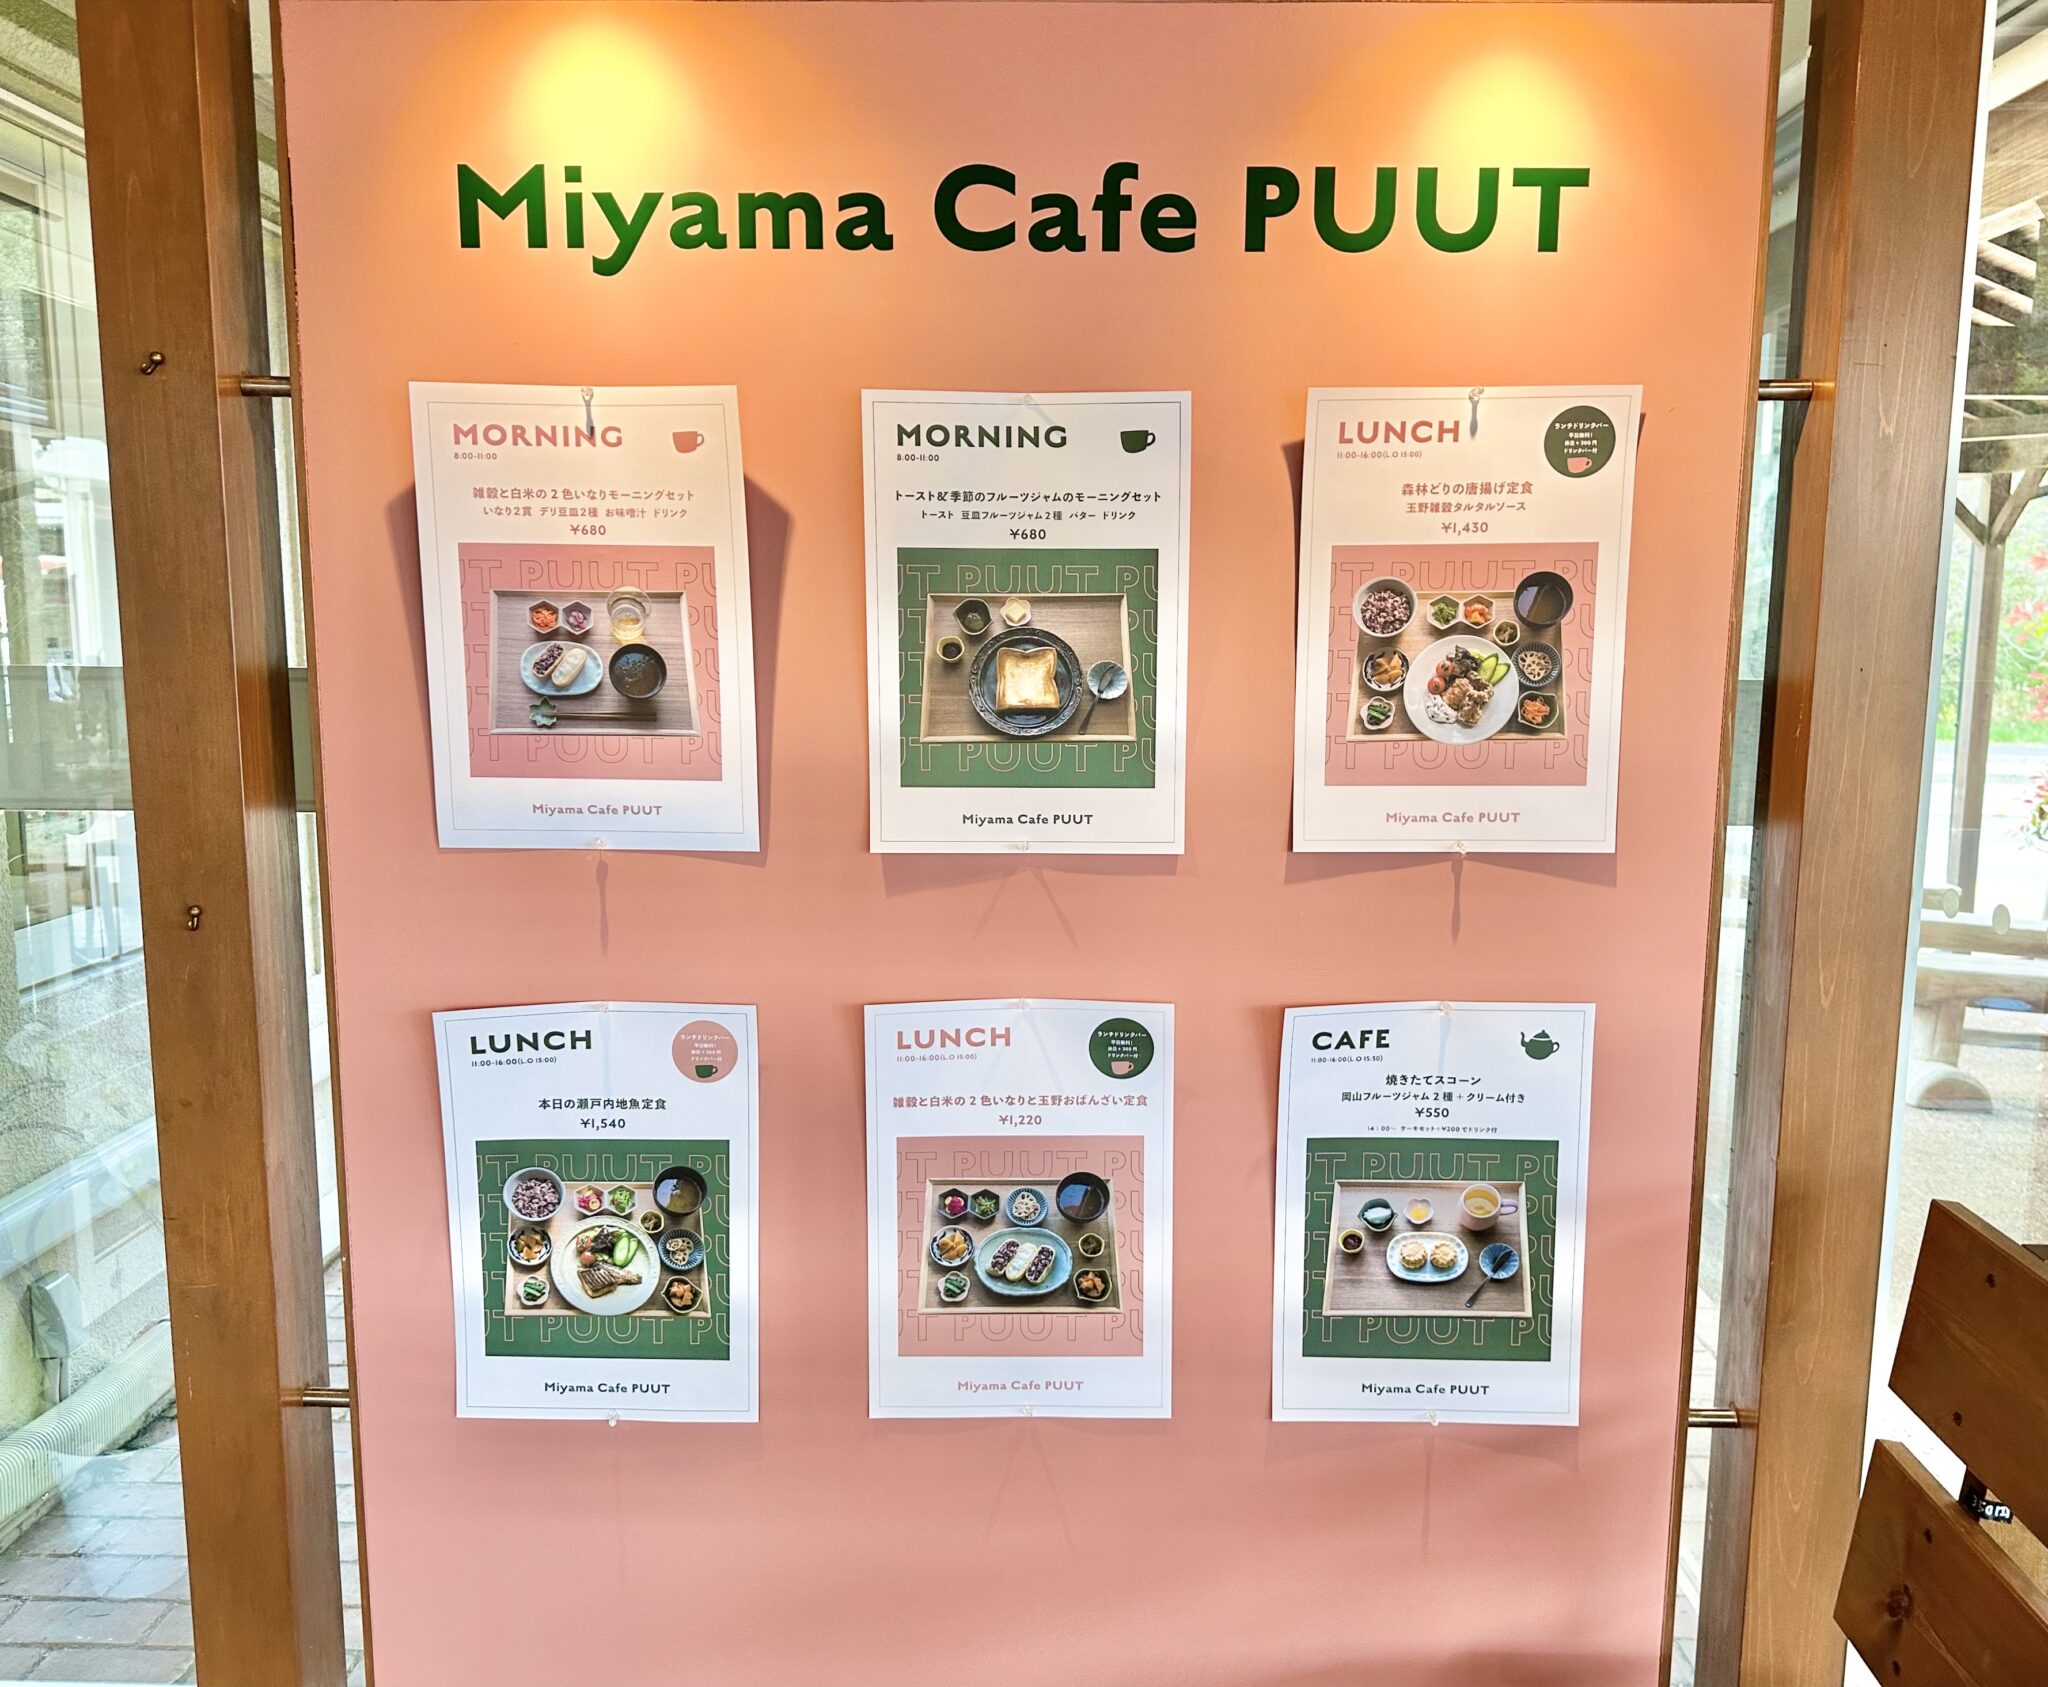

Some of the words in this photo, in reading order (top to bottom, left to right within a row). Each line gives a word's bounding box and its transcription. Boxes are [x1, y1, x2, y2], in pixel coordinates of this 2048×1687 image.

[456, 163, 894, 277] Miyama
[933, 161, 1197, 254] Cafe
[1244, 166, 1591, 254] PUUT
[453, 423, 623, 448] MORNING
[896, 423, 1067, 449] MORNING
[1338, 420, 1460, 445] LUNCH
[453, 451, 498, 461] 8:00-11:00
[896, 453, 940, 462] 8:00-11:00
[1401, 480, 1534, 497] 森林どりの唐揚げ定食
[653, 508, 688, 519] ドリンク
[921, 509, 954, 520] トースト
[1068, 511, 1096, 521] バター
[1103, 510, 1136, 521] ドリンク
[570, 524, 607, 536] ¥680
[1009, 528, 1047, 540] ¥680
[1441, 521, 1489, 537] ¥1,430
[957, 565, 1099, 593] PUUT
[958, 742, 1098, 772] PUUT
[532, 803, 584, 817] Miyama
[587, 804, 619, 815] Cafe
[622, 805, 663, 816] PUUT
[962, 814, 1014, 828] Miyama
[1017, 813, 1049, 825] Cafe
[1053, 814, 1094, 825] PUUT
[1385, 812, 1438, 826] Miyama
[1441, 811, 1474, 823] Cafe
[1478, 812, 1521, 823] PUUT
[470, 1029, 592, 1055] LUNCH
[897, 1026, 1011, 1050] LUNCH
[1311, 1028, 1390, 1051] CAFE
[1385, 1073, 1482, 1086] 焼きたてスコーン
[538, 1097, 667, 1110] 本日の瀬戸内地魚定食
[1415, 1107, 1450, 1118] ¥550
[580, 1118, 626, 1131] ¥1,540
[998, 1114, 1042, 1128] ¥1,220
[953, 1151, 1087, 1178] PUUT
[1362, 1152, 1500, 1180] PUUT
[544, 1382, 594, 1395] Miyama
[597, 1382, 628, 1393] Cafe
[632, 1383, 671, 1394] PUUT
[957, 1380, 1007, 1394] Miyama
[1010, 1379, 1041, 1391] Cafe
[1044, 1380, 1084, 1391] PUUT
[1361, 1383, 1412, 1396] Miyama
[1415, 1383, 1446, 1394] Cafe
[1450, 1384, 1490, 1395] PUUT
